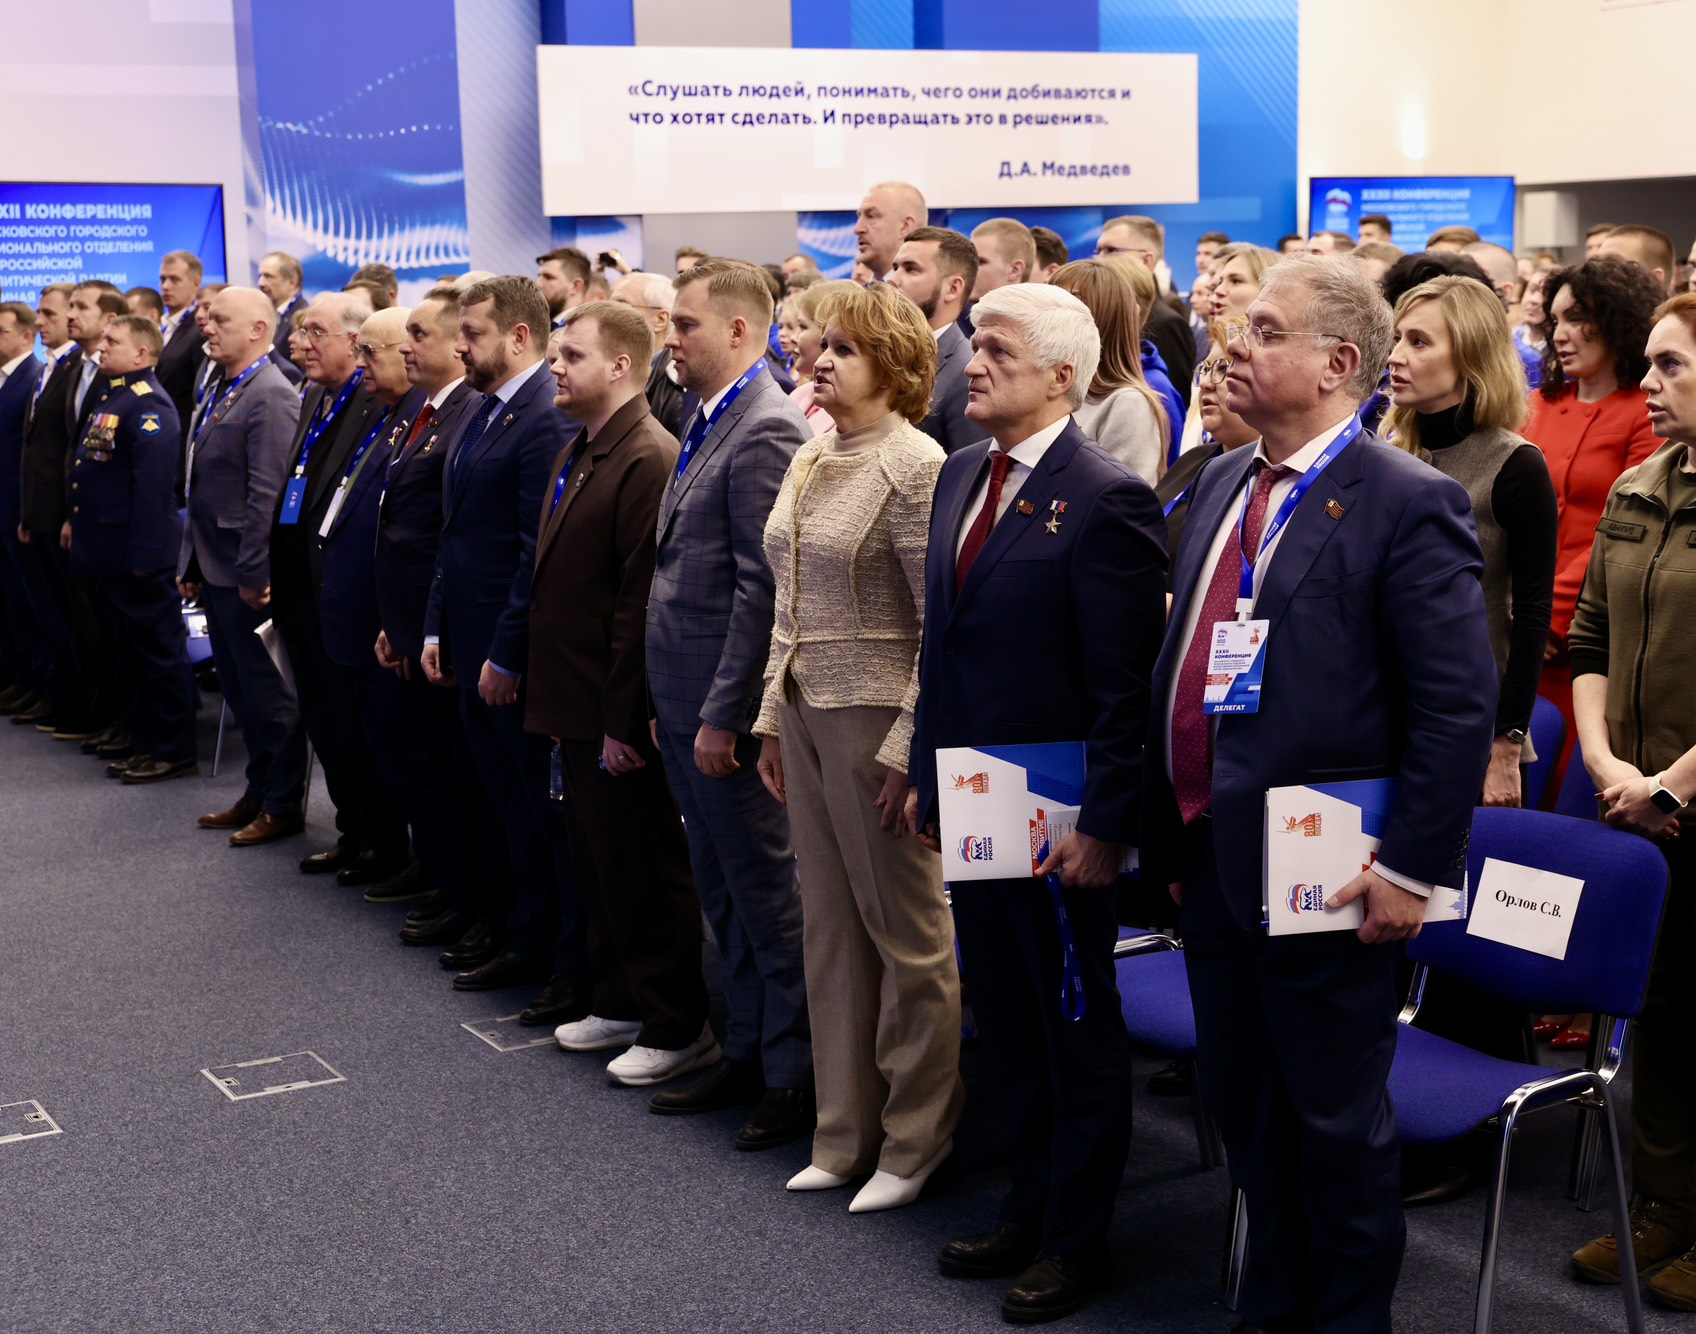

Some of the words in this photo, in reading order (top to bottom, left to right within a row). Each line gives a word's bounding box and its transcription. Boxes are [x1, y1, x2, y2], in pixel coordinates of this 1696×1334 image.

[628, 80, 733, 101] «Слушать
[738, 82, 812, 100] людей,
[817, 86, 916, 101] понимать,
[921, 87, 963, 99] чего
[968, 87, 1002, 99] они
[1006, 84, 1116, 101] добиваются
[1121, 89, 1131, 99] и
[629, 112, 664, 125] что
[670, 112, 726, 125] хотят
[731, 112, 817, 127] сделать.
[823, 109, 836, 124] И
[841, 113, 960, 129] превращать
[965, 113, 994, 126] это
[998, 113, 1008, 125] в
[998, 161, 1037, 179] Д.А.
[1041, 161, 1131, 178] Медведев
[25, 203, 152, 221] КОНФЕРЕНЦИЯ
[69, 225, 149, 239] ГОРОДСКОГО
[83, 241, 154, 255] ОТДЕЛЕНИЯ
[1213, 704, 1245, 713] ДЕЛЕГАТ
[1030, 826, 1038, 860] МОСКВА
[1495, 889, 1538, 911] Орлов
[1540, 901, 1562, 918] С.В.
